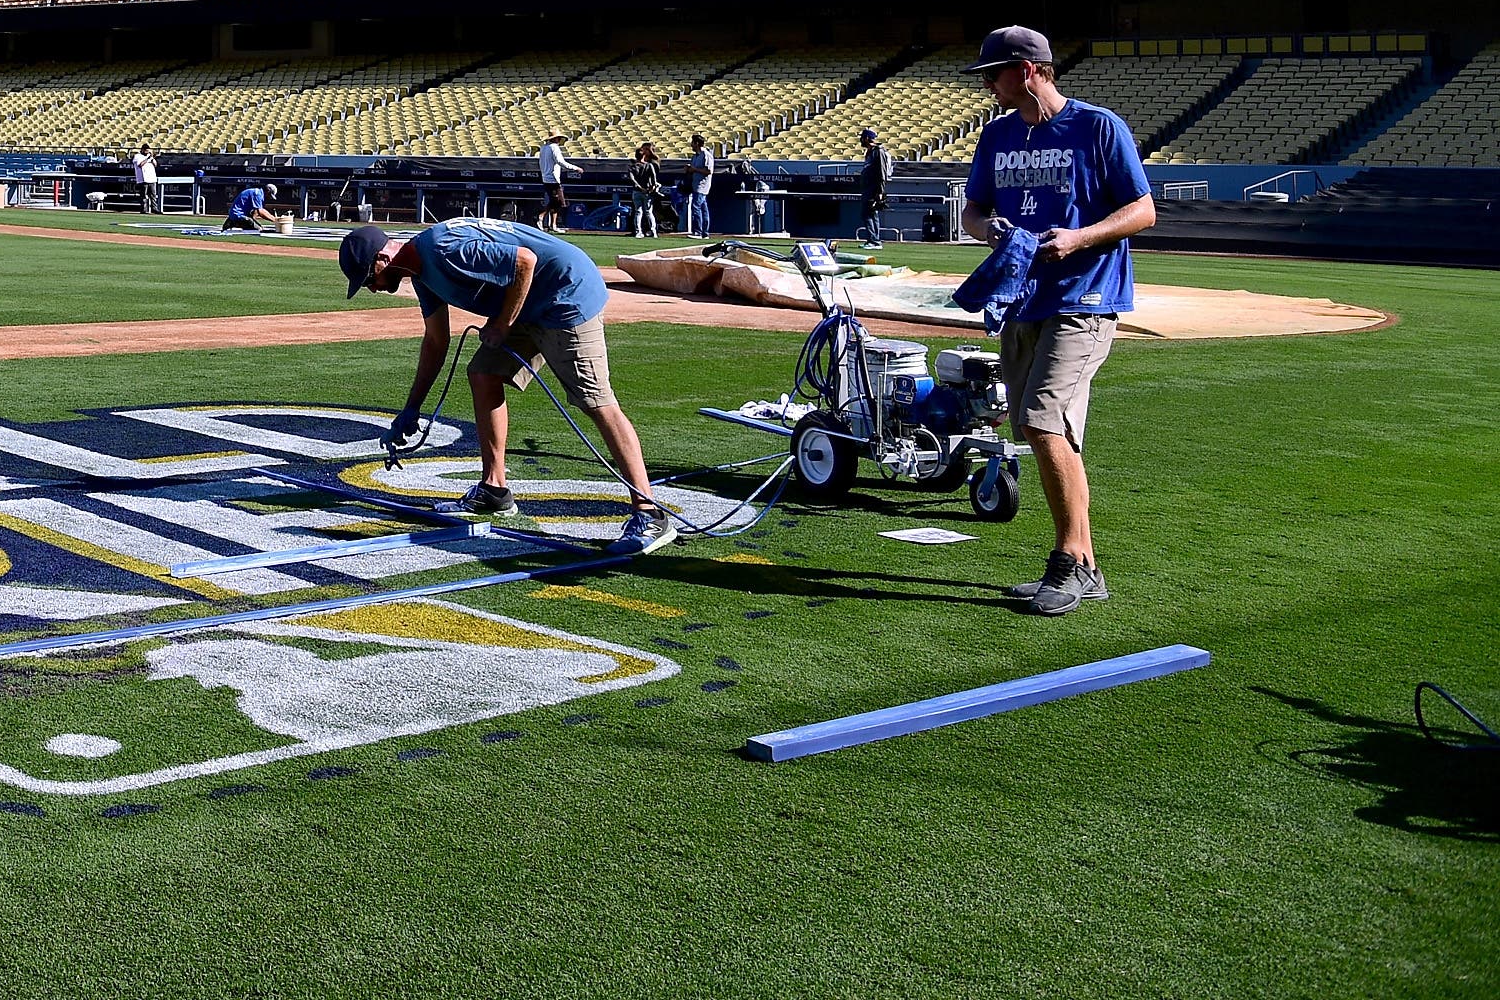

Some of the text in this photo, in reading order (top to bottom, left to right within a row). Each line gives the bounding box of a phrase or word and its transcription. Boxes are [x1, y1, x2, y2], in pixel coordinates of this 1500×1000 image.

[994, 149, 1074, 171] DODGERS
[995, 167, 1071, 188] BASEBALL
[1020, 190, 1038, 216] LA
